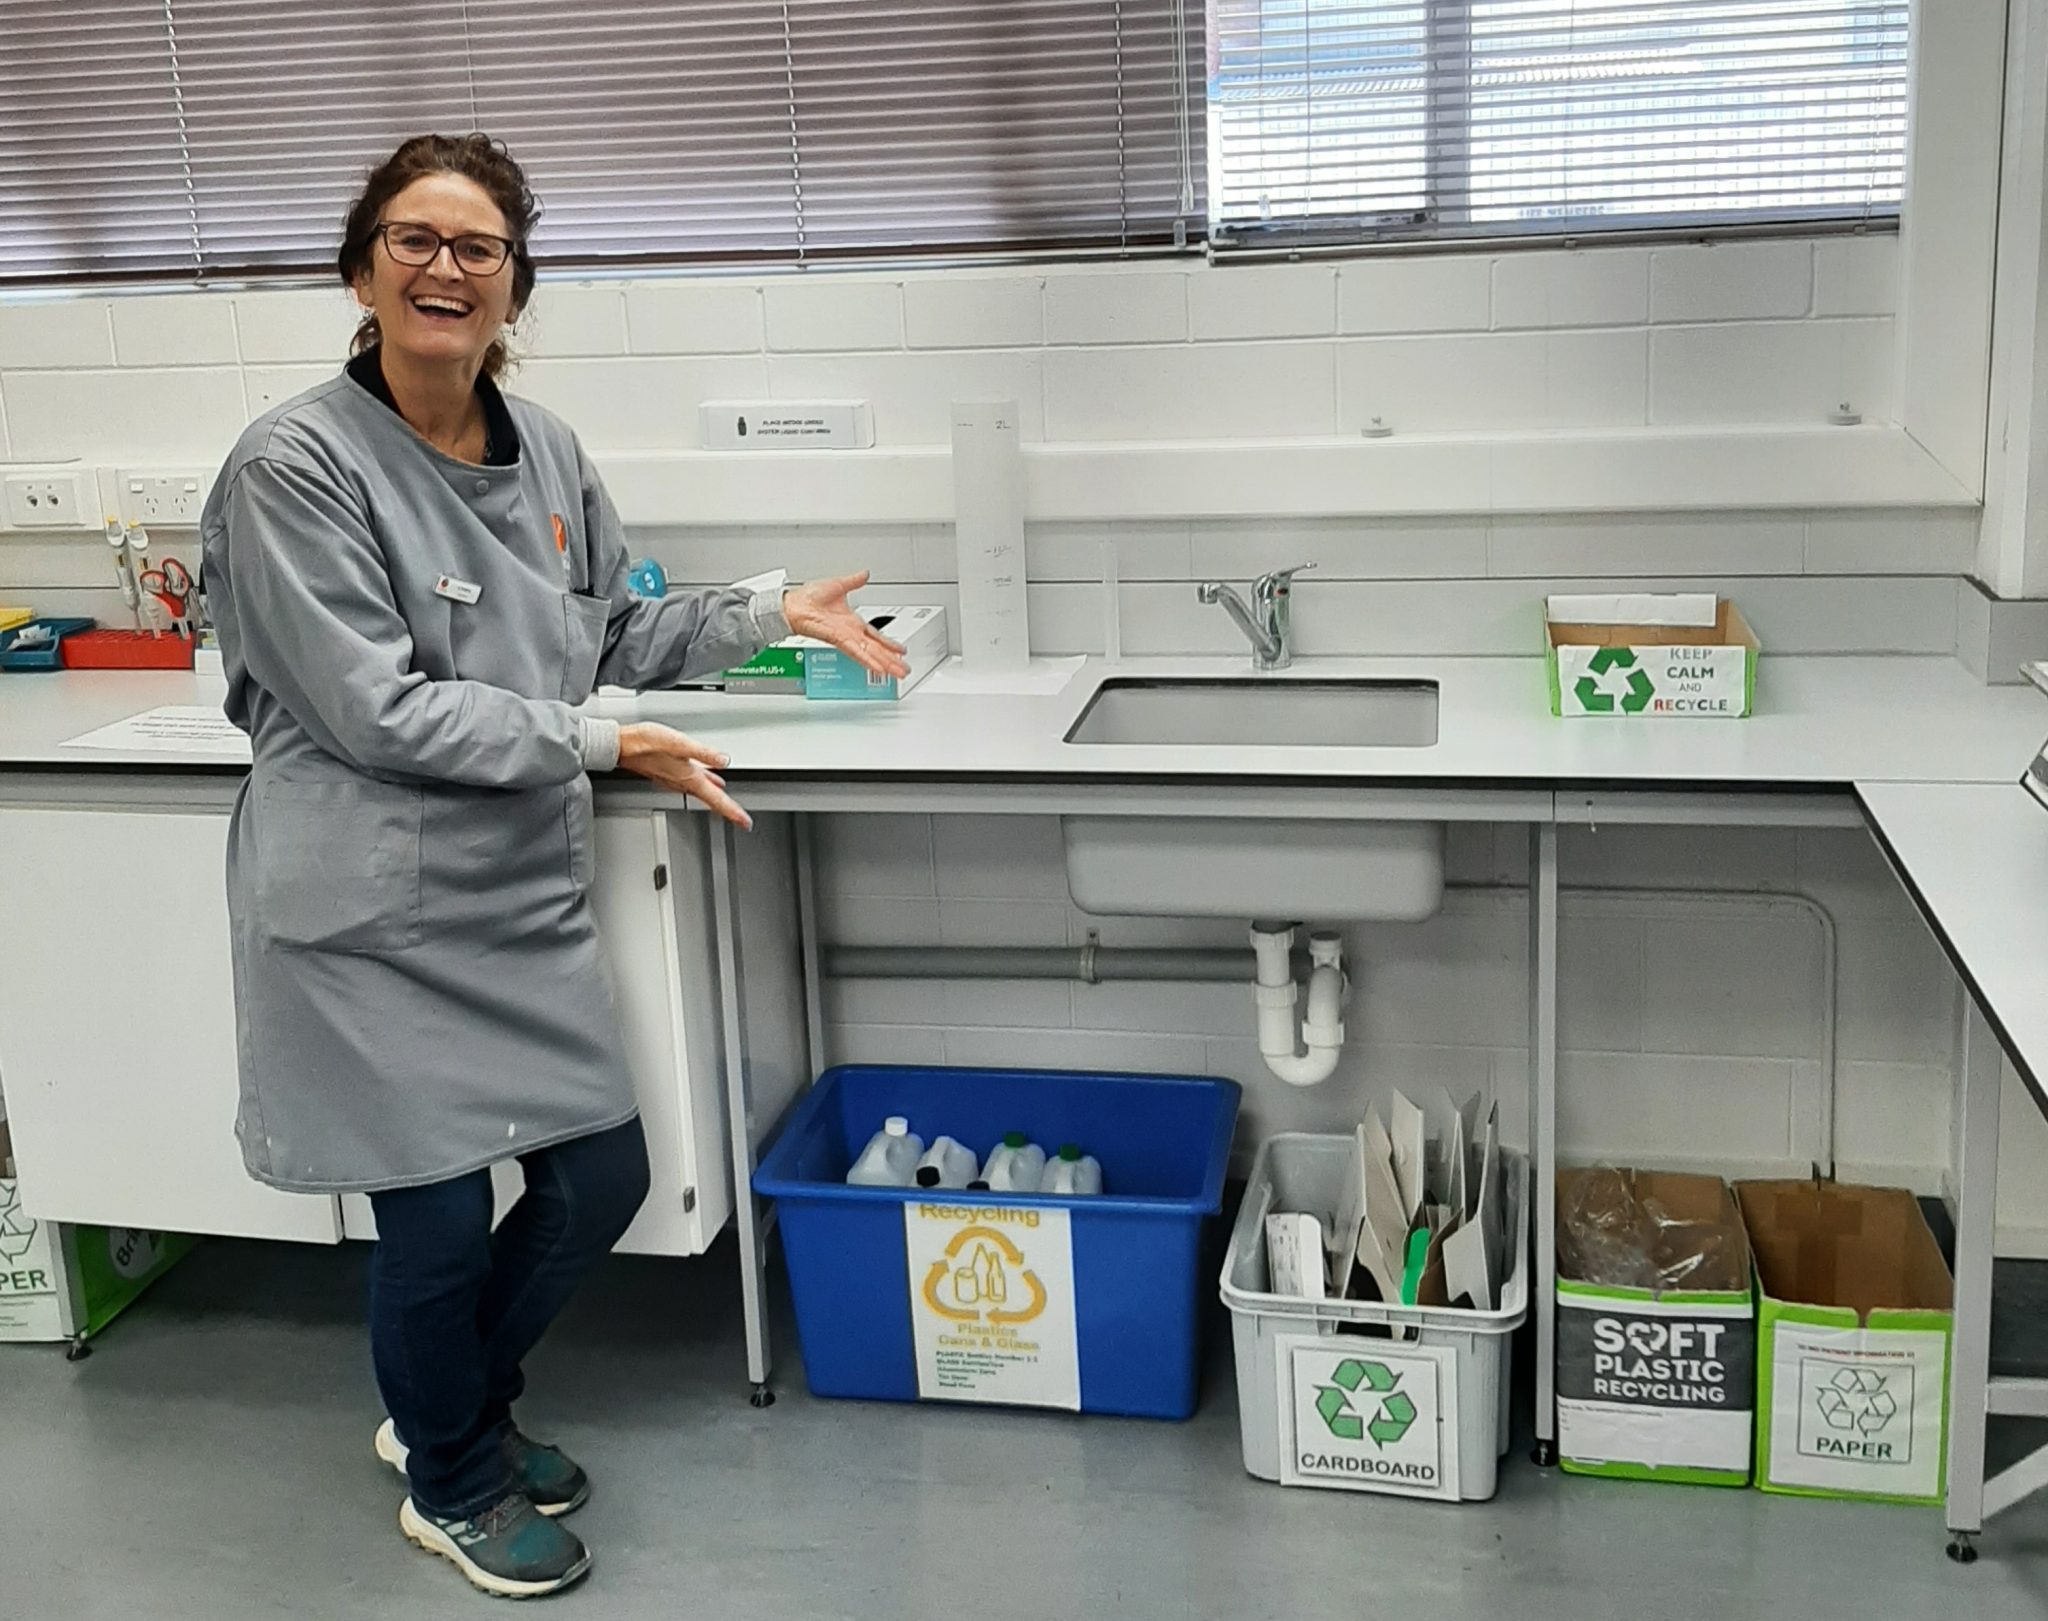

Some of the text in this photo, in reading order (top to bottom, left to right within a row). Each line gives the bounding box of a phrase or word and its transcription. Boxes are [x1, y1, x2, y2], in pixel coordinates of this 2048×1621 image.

[1670, 648, 1712, 660] KEEP
[1667, 667, 1714, 679] CALM
[1679, 683, 1702, 692] AND
[1654, 699, 1728, 711] RECYCLE
[919, 1204, 1040, 1228] Recycling
[1594, 1353, 1725, 1383] PLASTIC
[1593, 1378, 1726, 1403] RECYCLING
[1816, 1437, 1893, 1458] PAPER
[1301, 1453, 1435, 1480] CARDBOARD
